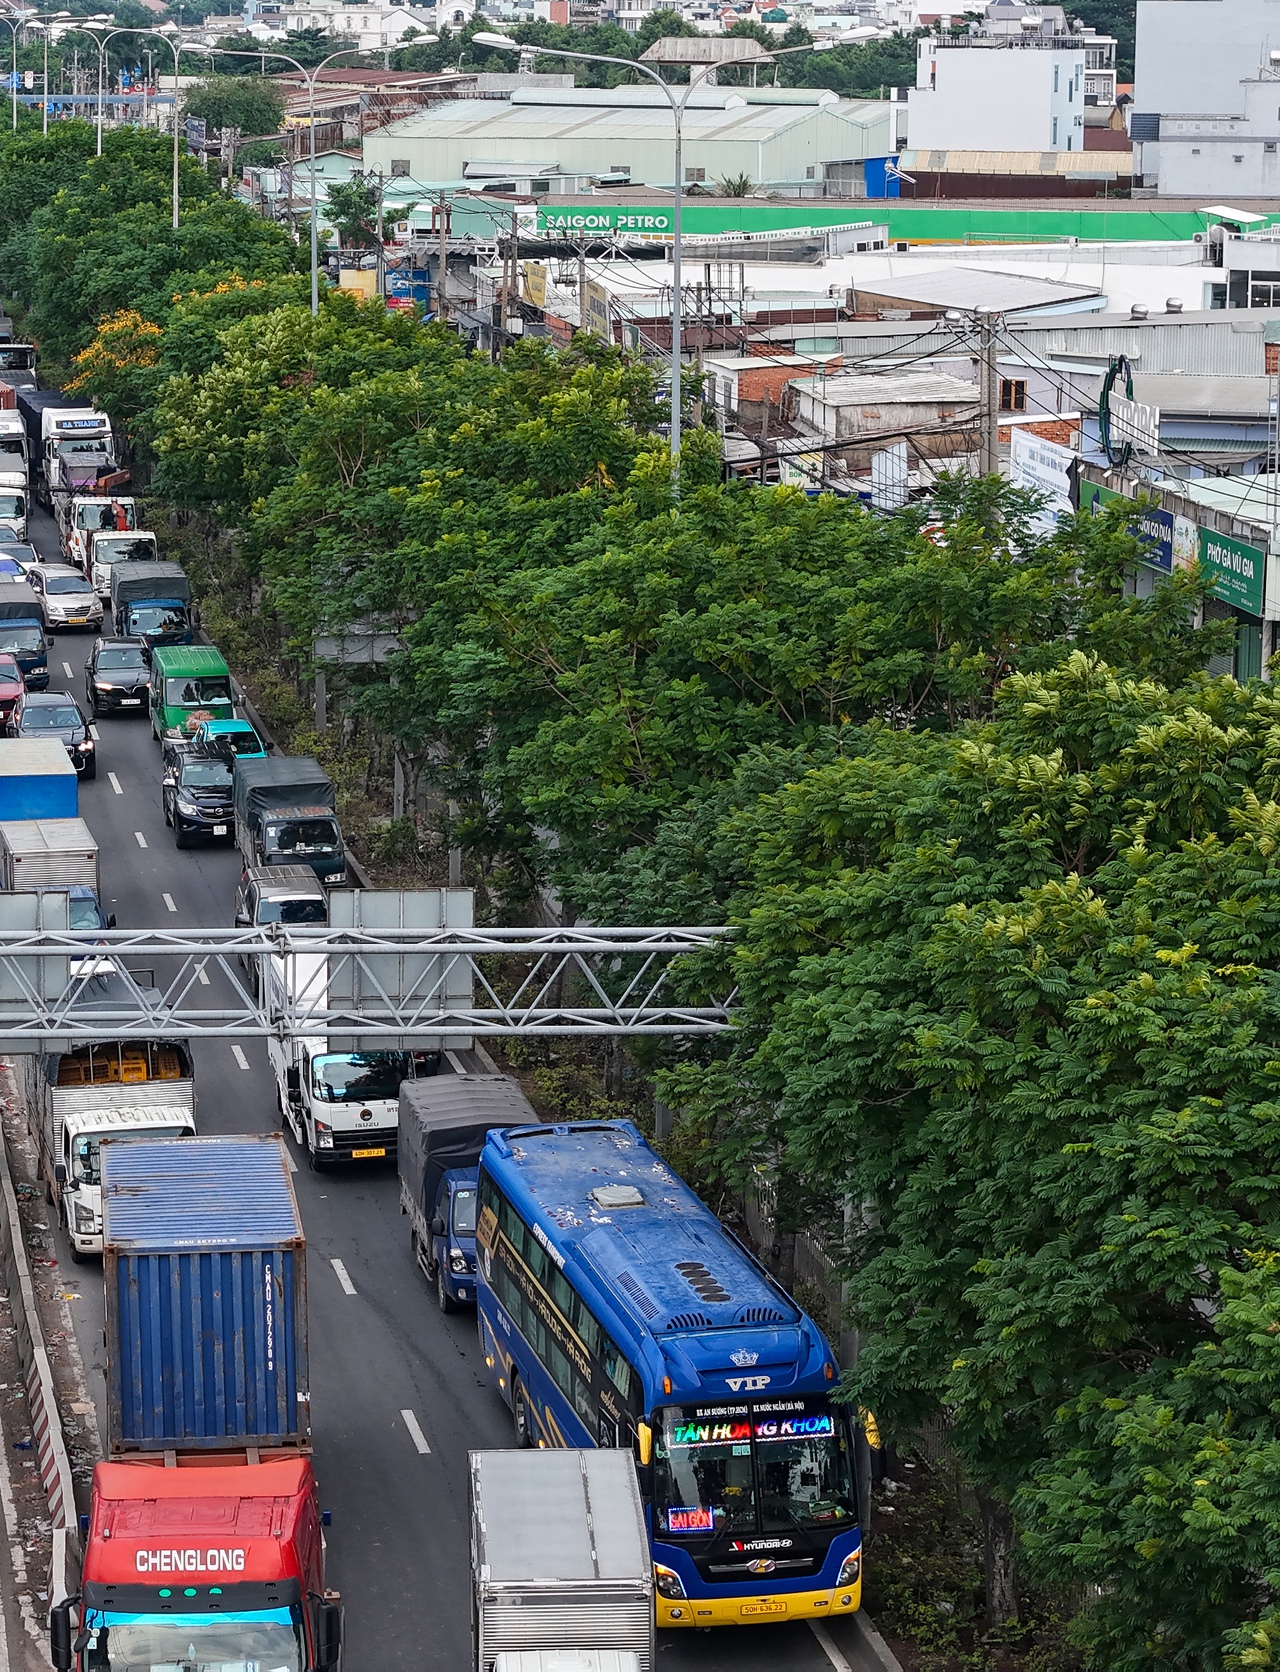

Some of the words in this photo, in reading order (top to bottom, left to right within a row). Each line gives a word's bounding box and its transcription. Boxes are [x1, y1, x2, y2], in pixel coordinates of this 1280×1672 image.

[546, 215, 610, 228] SAIGON
[617, 215, 669, 229] PETRO
[1242, 558, 1254, 580] GIA
[264, 1264, 272, 1301] CMAU
[725, 1375, 770, 1392] VIP
[674, 1422, 709, 1443] TÂN
[780, 1415, 830, 1434] KHOA
[743, 1542, 780, 1551] HYUNDAI
[136, 1549, 245, 1572] CHENGLONG
